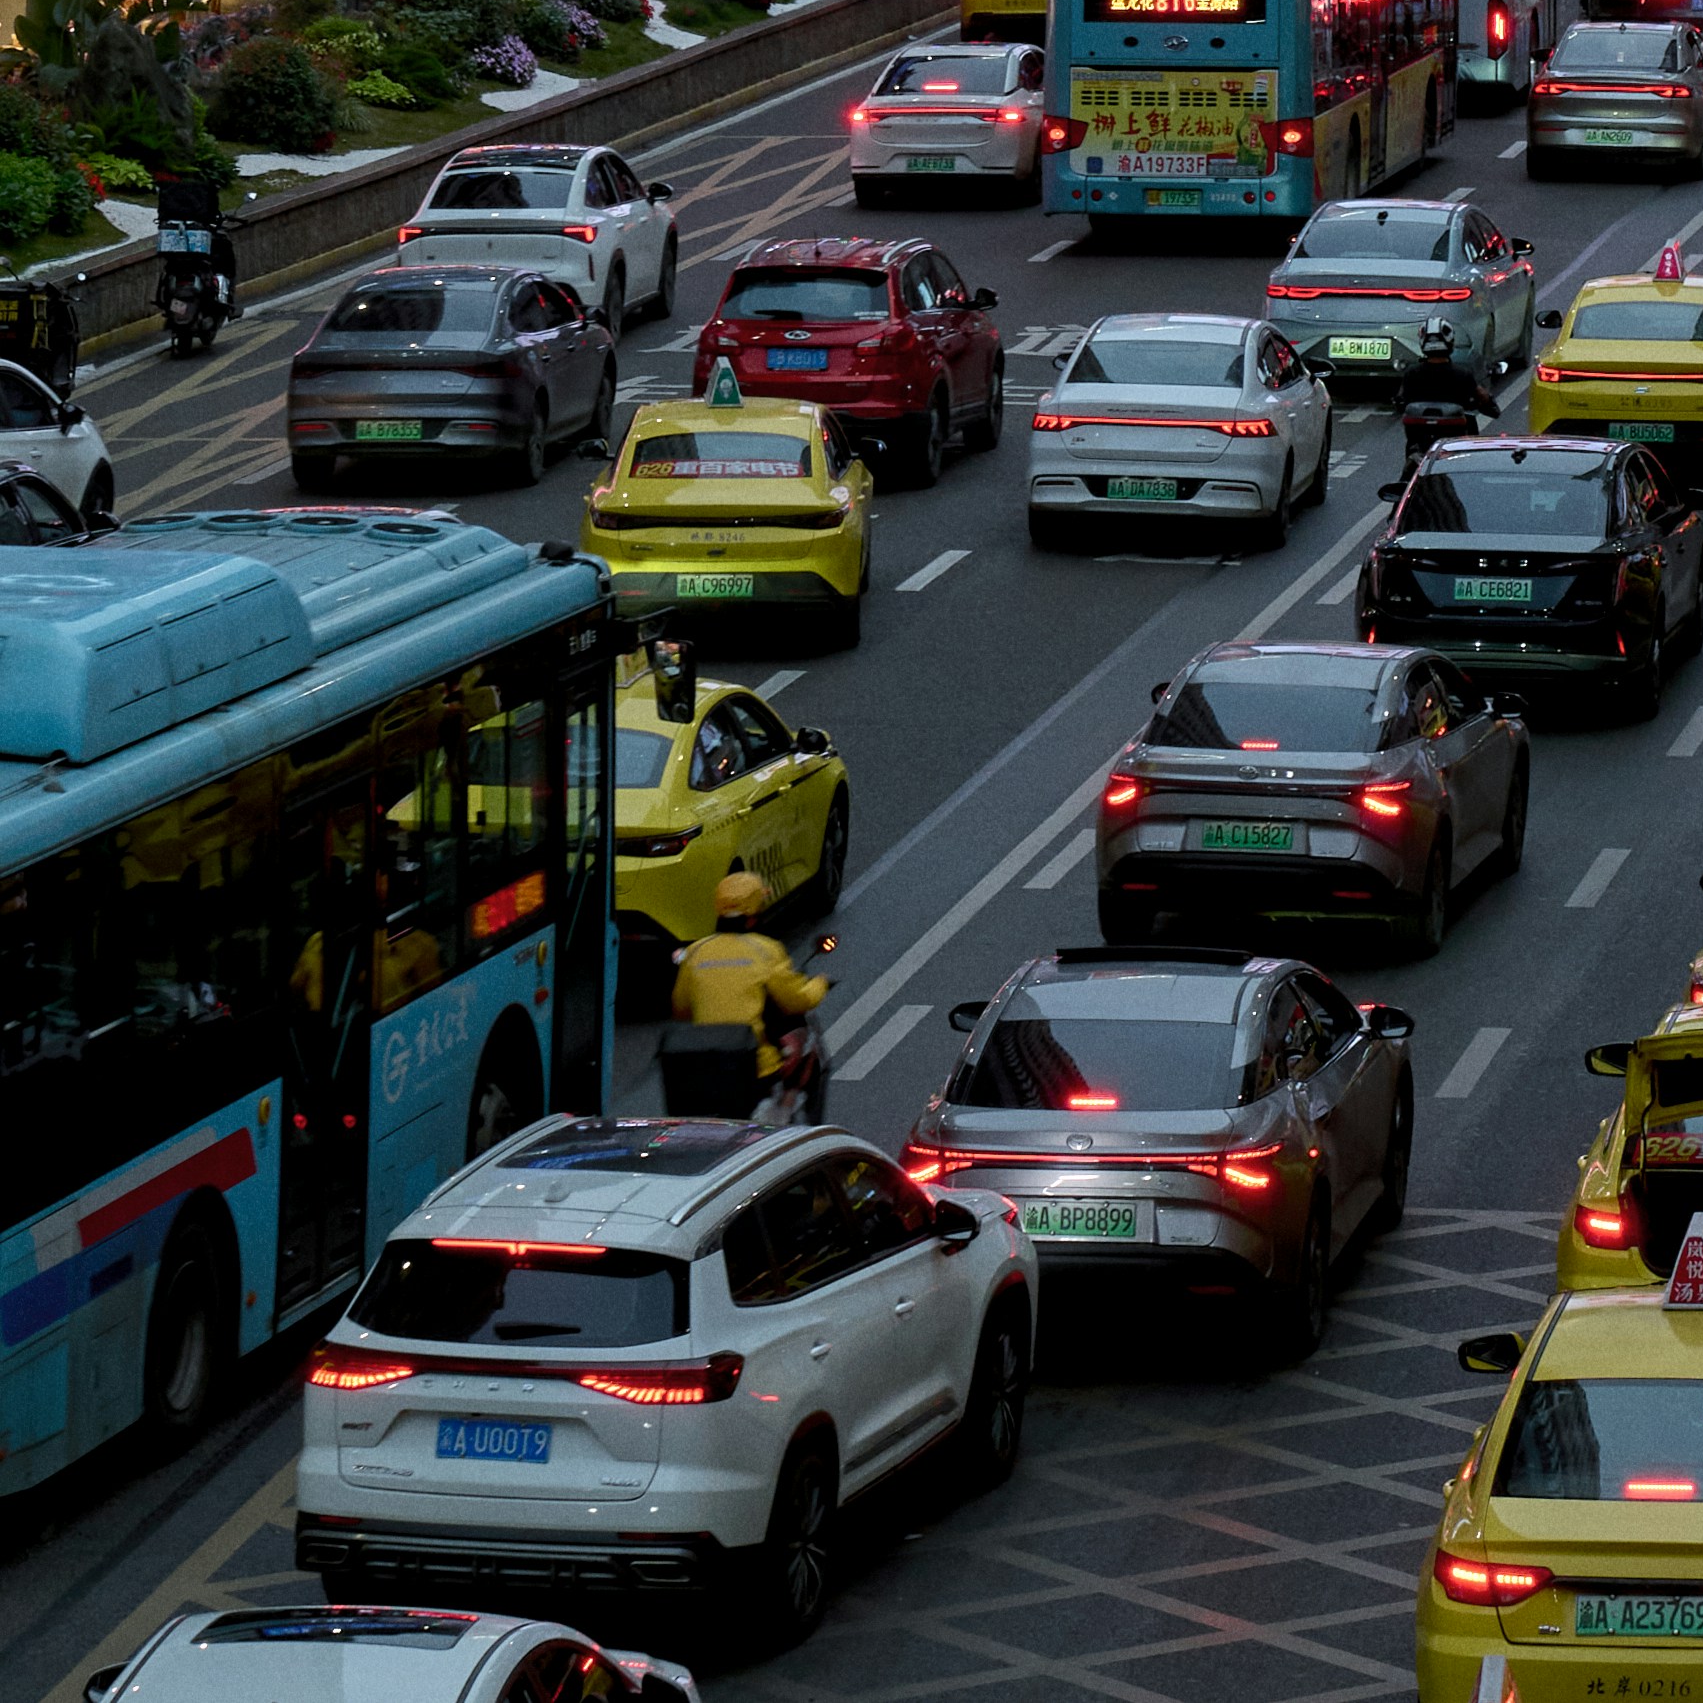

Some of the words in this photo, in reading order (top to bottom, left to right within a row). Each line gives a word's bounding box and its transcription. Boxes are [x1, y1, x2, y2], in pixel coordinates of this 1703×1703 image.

[1174, 115, 1231, 139] 花椒油
[636, 460, 801, 477] 626重百家电节
[702, 578, 751, 594] C96997
[1479, 582, 1529, 598] CE6821
[1231, 821, 1291, 847] C15827
[1060, 1206, 1134, 1234] BP8899
[1639, 1680, 1690, 1698] 0216
